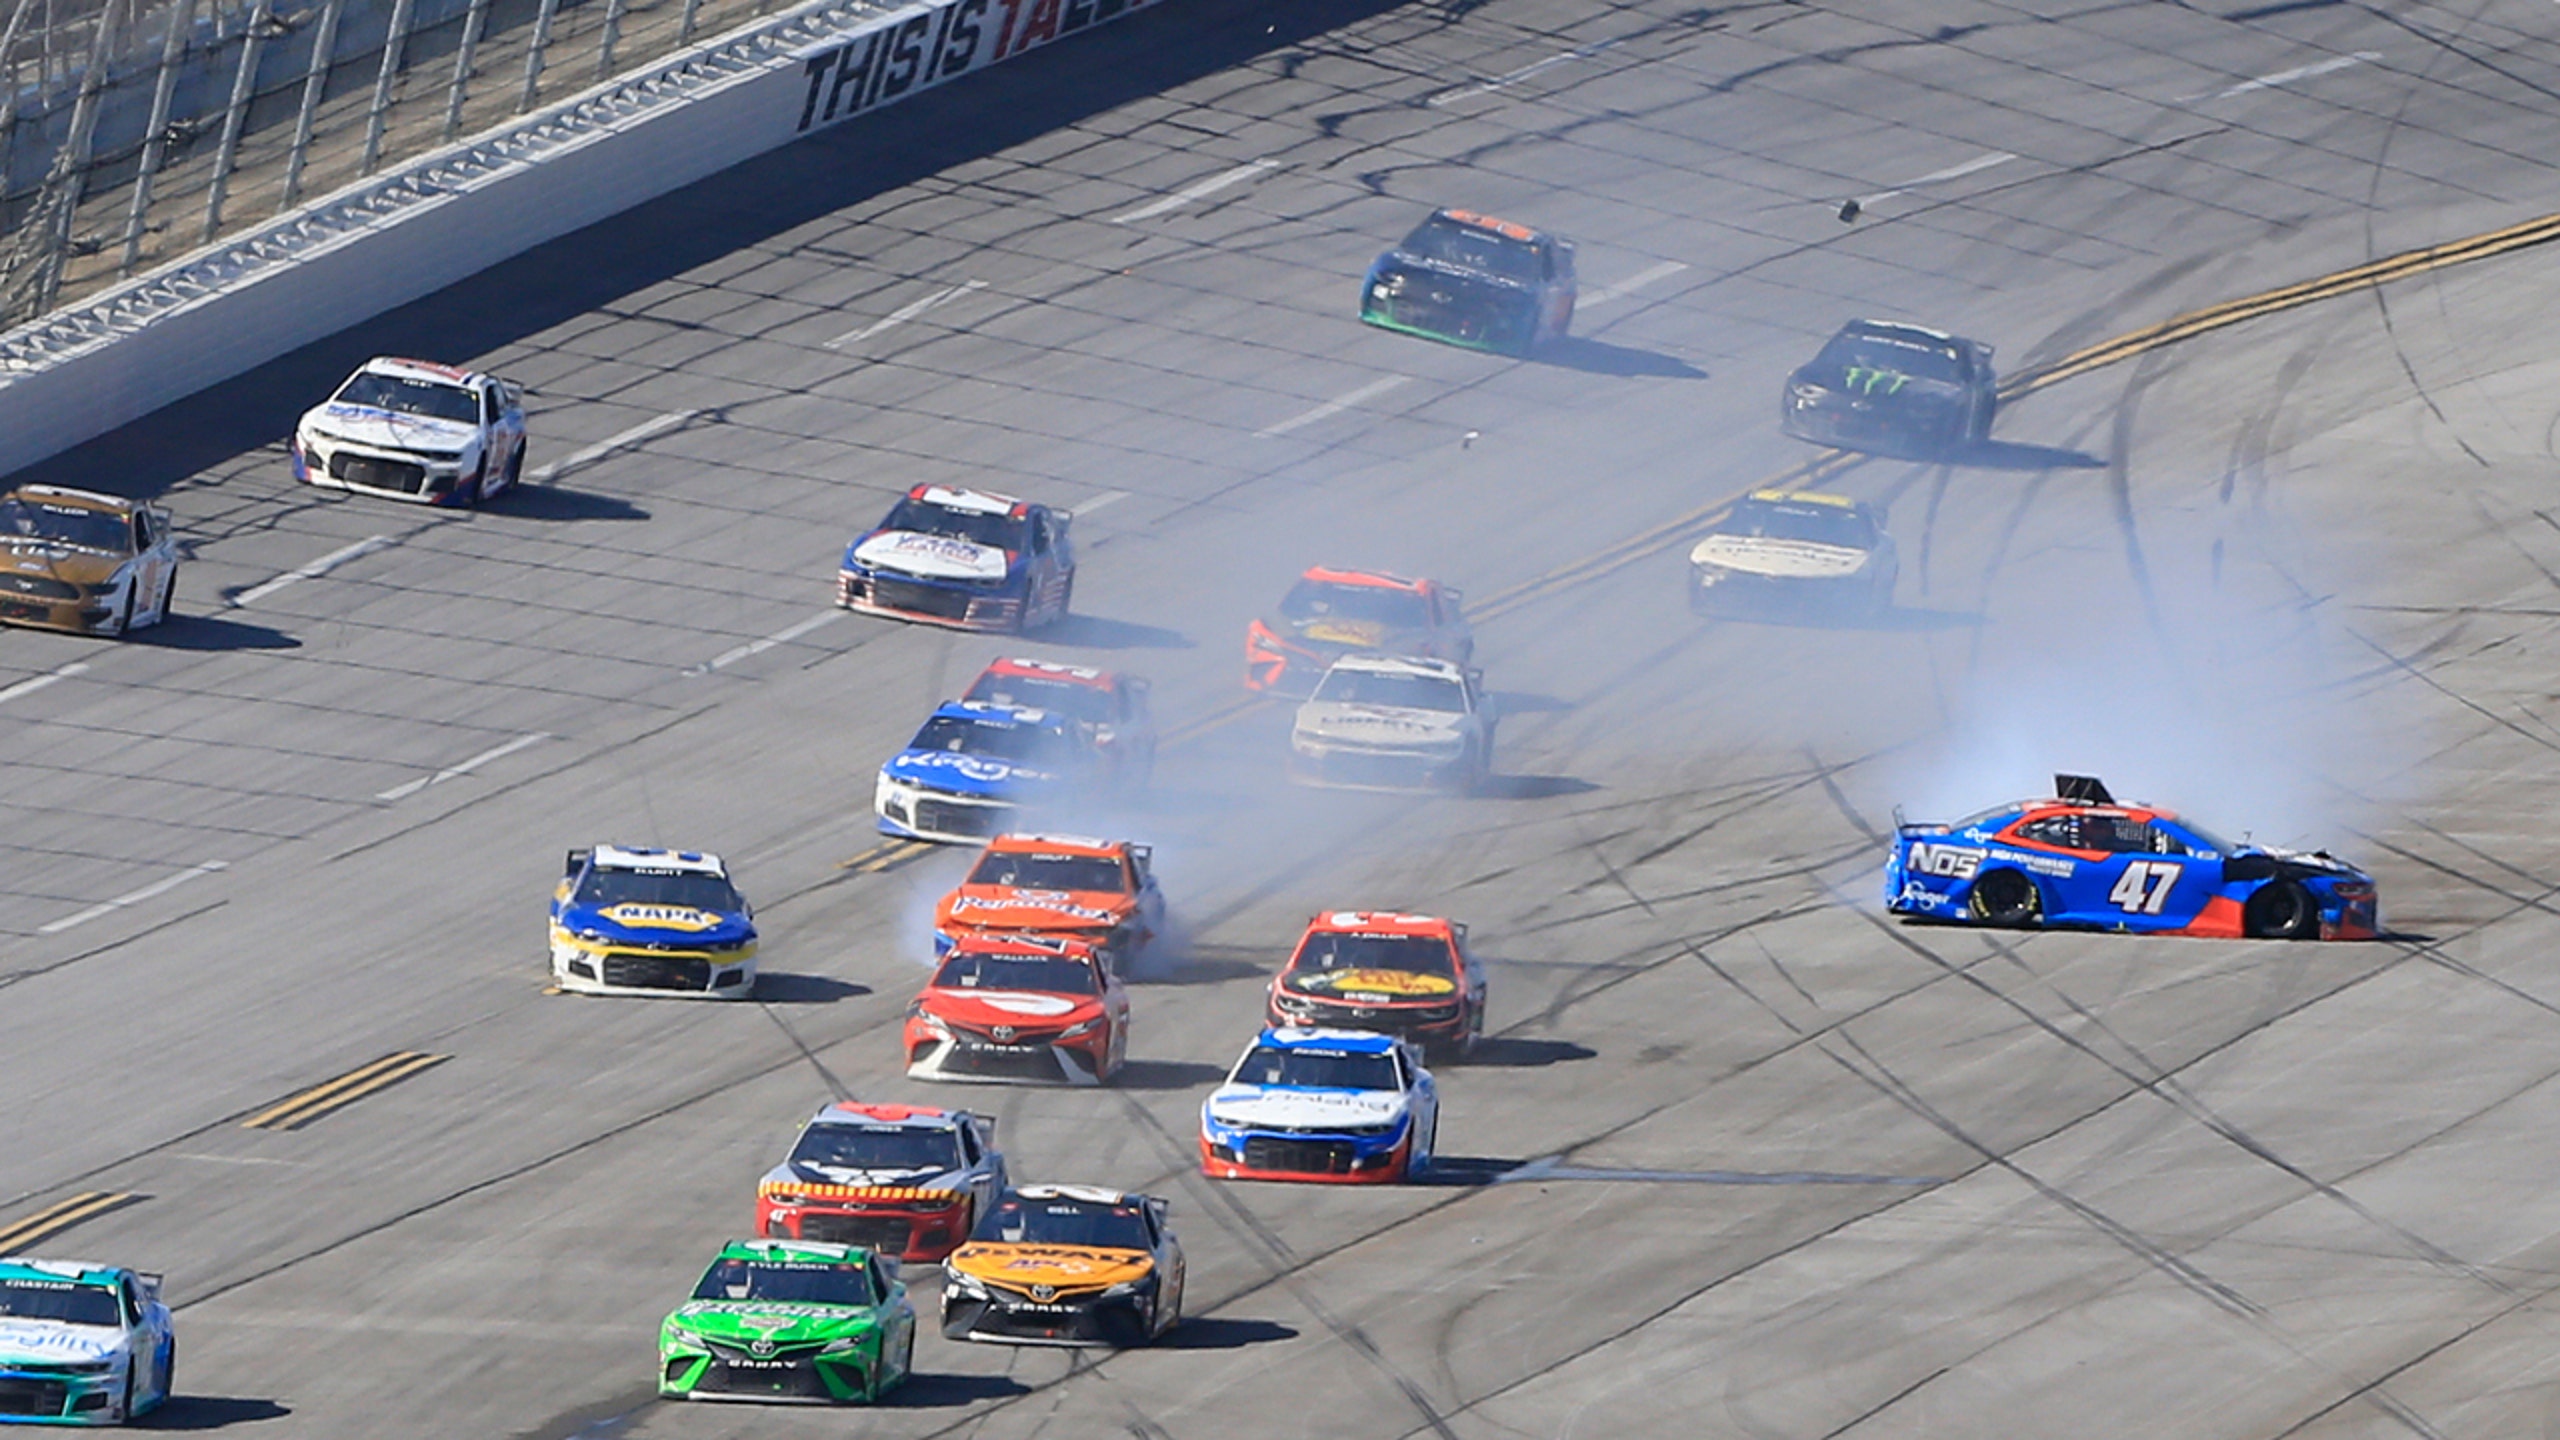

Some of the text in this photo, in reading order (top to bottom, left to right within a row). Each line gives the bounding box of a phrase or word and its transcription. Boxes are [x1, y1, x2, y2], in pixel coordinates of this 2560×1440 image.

[797, 16, 932, 131] THIS
[924, 1, 988, 81] IS
[1907, 841, 1988, 880] NOS
[2109, 860, 2183, 915] 47
[620, 908, 702, 924] NAPA
